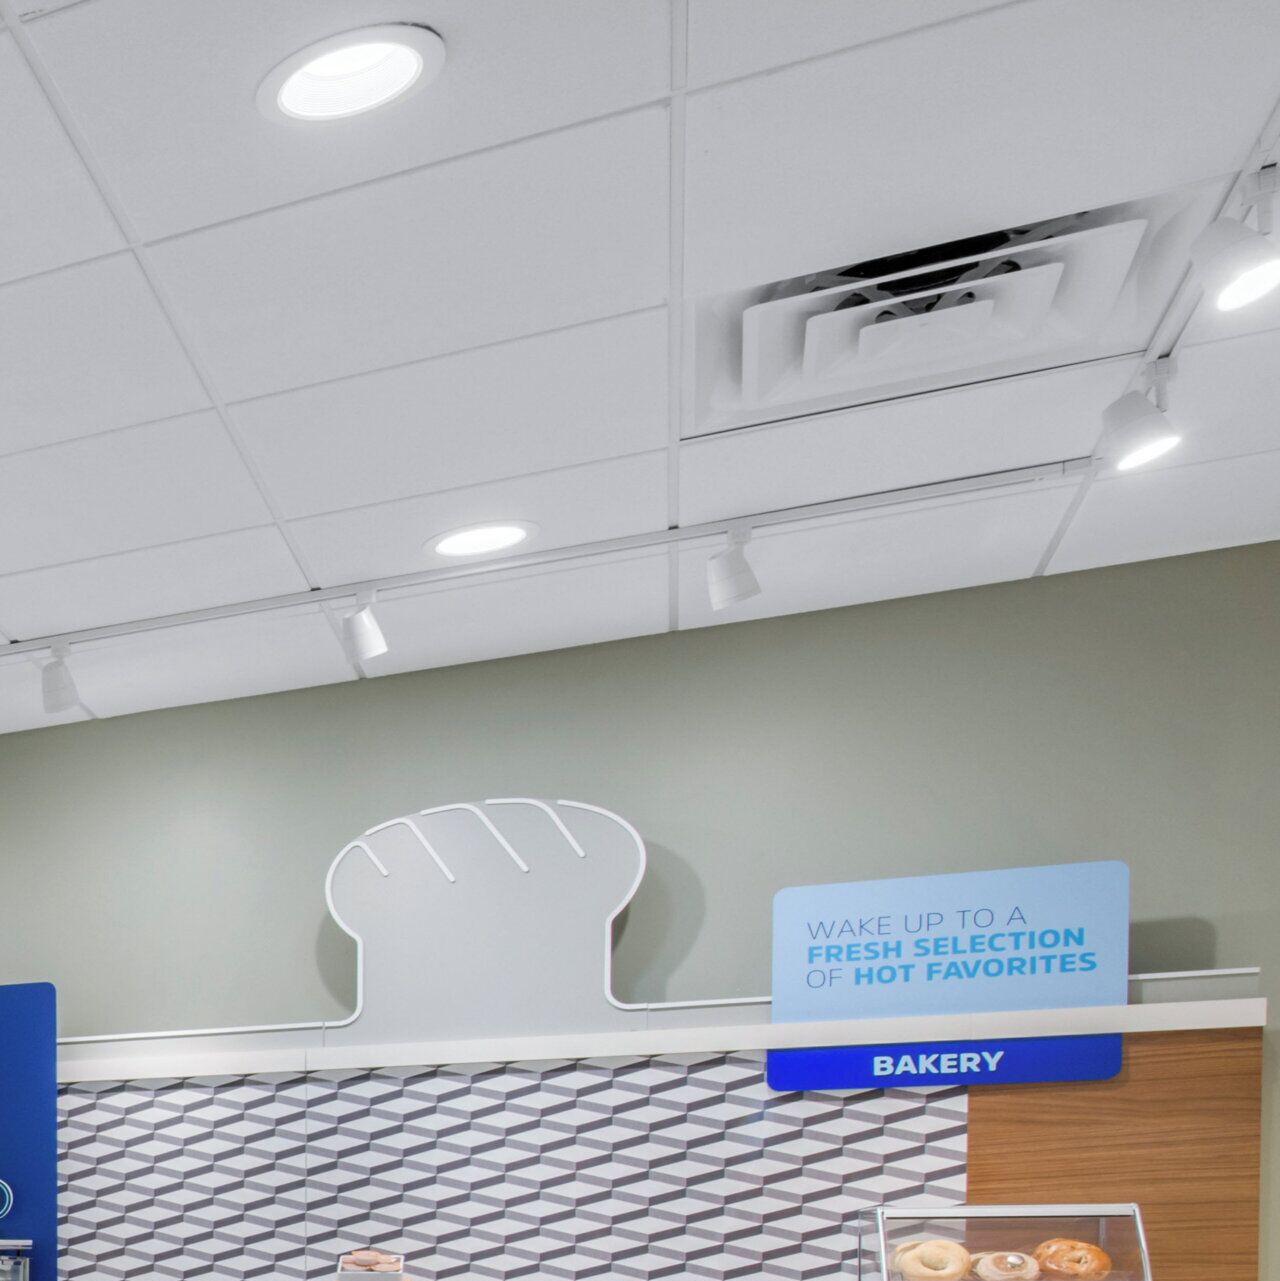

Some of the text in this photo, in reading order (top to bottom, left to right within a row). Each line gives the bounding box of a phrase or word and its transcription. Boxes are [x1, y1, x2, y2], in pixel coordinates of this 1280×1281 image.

[807, 906, 1027, 940] WAKE UP TO A
[807, 927, 1085, 964] FRESH SELECTION
[806, 952, 1098, 989] OF HOT FAVORITES
[872, 1051, 1005, 1077] BAKERY
